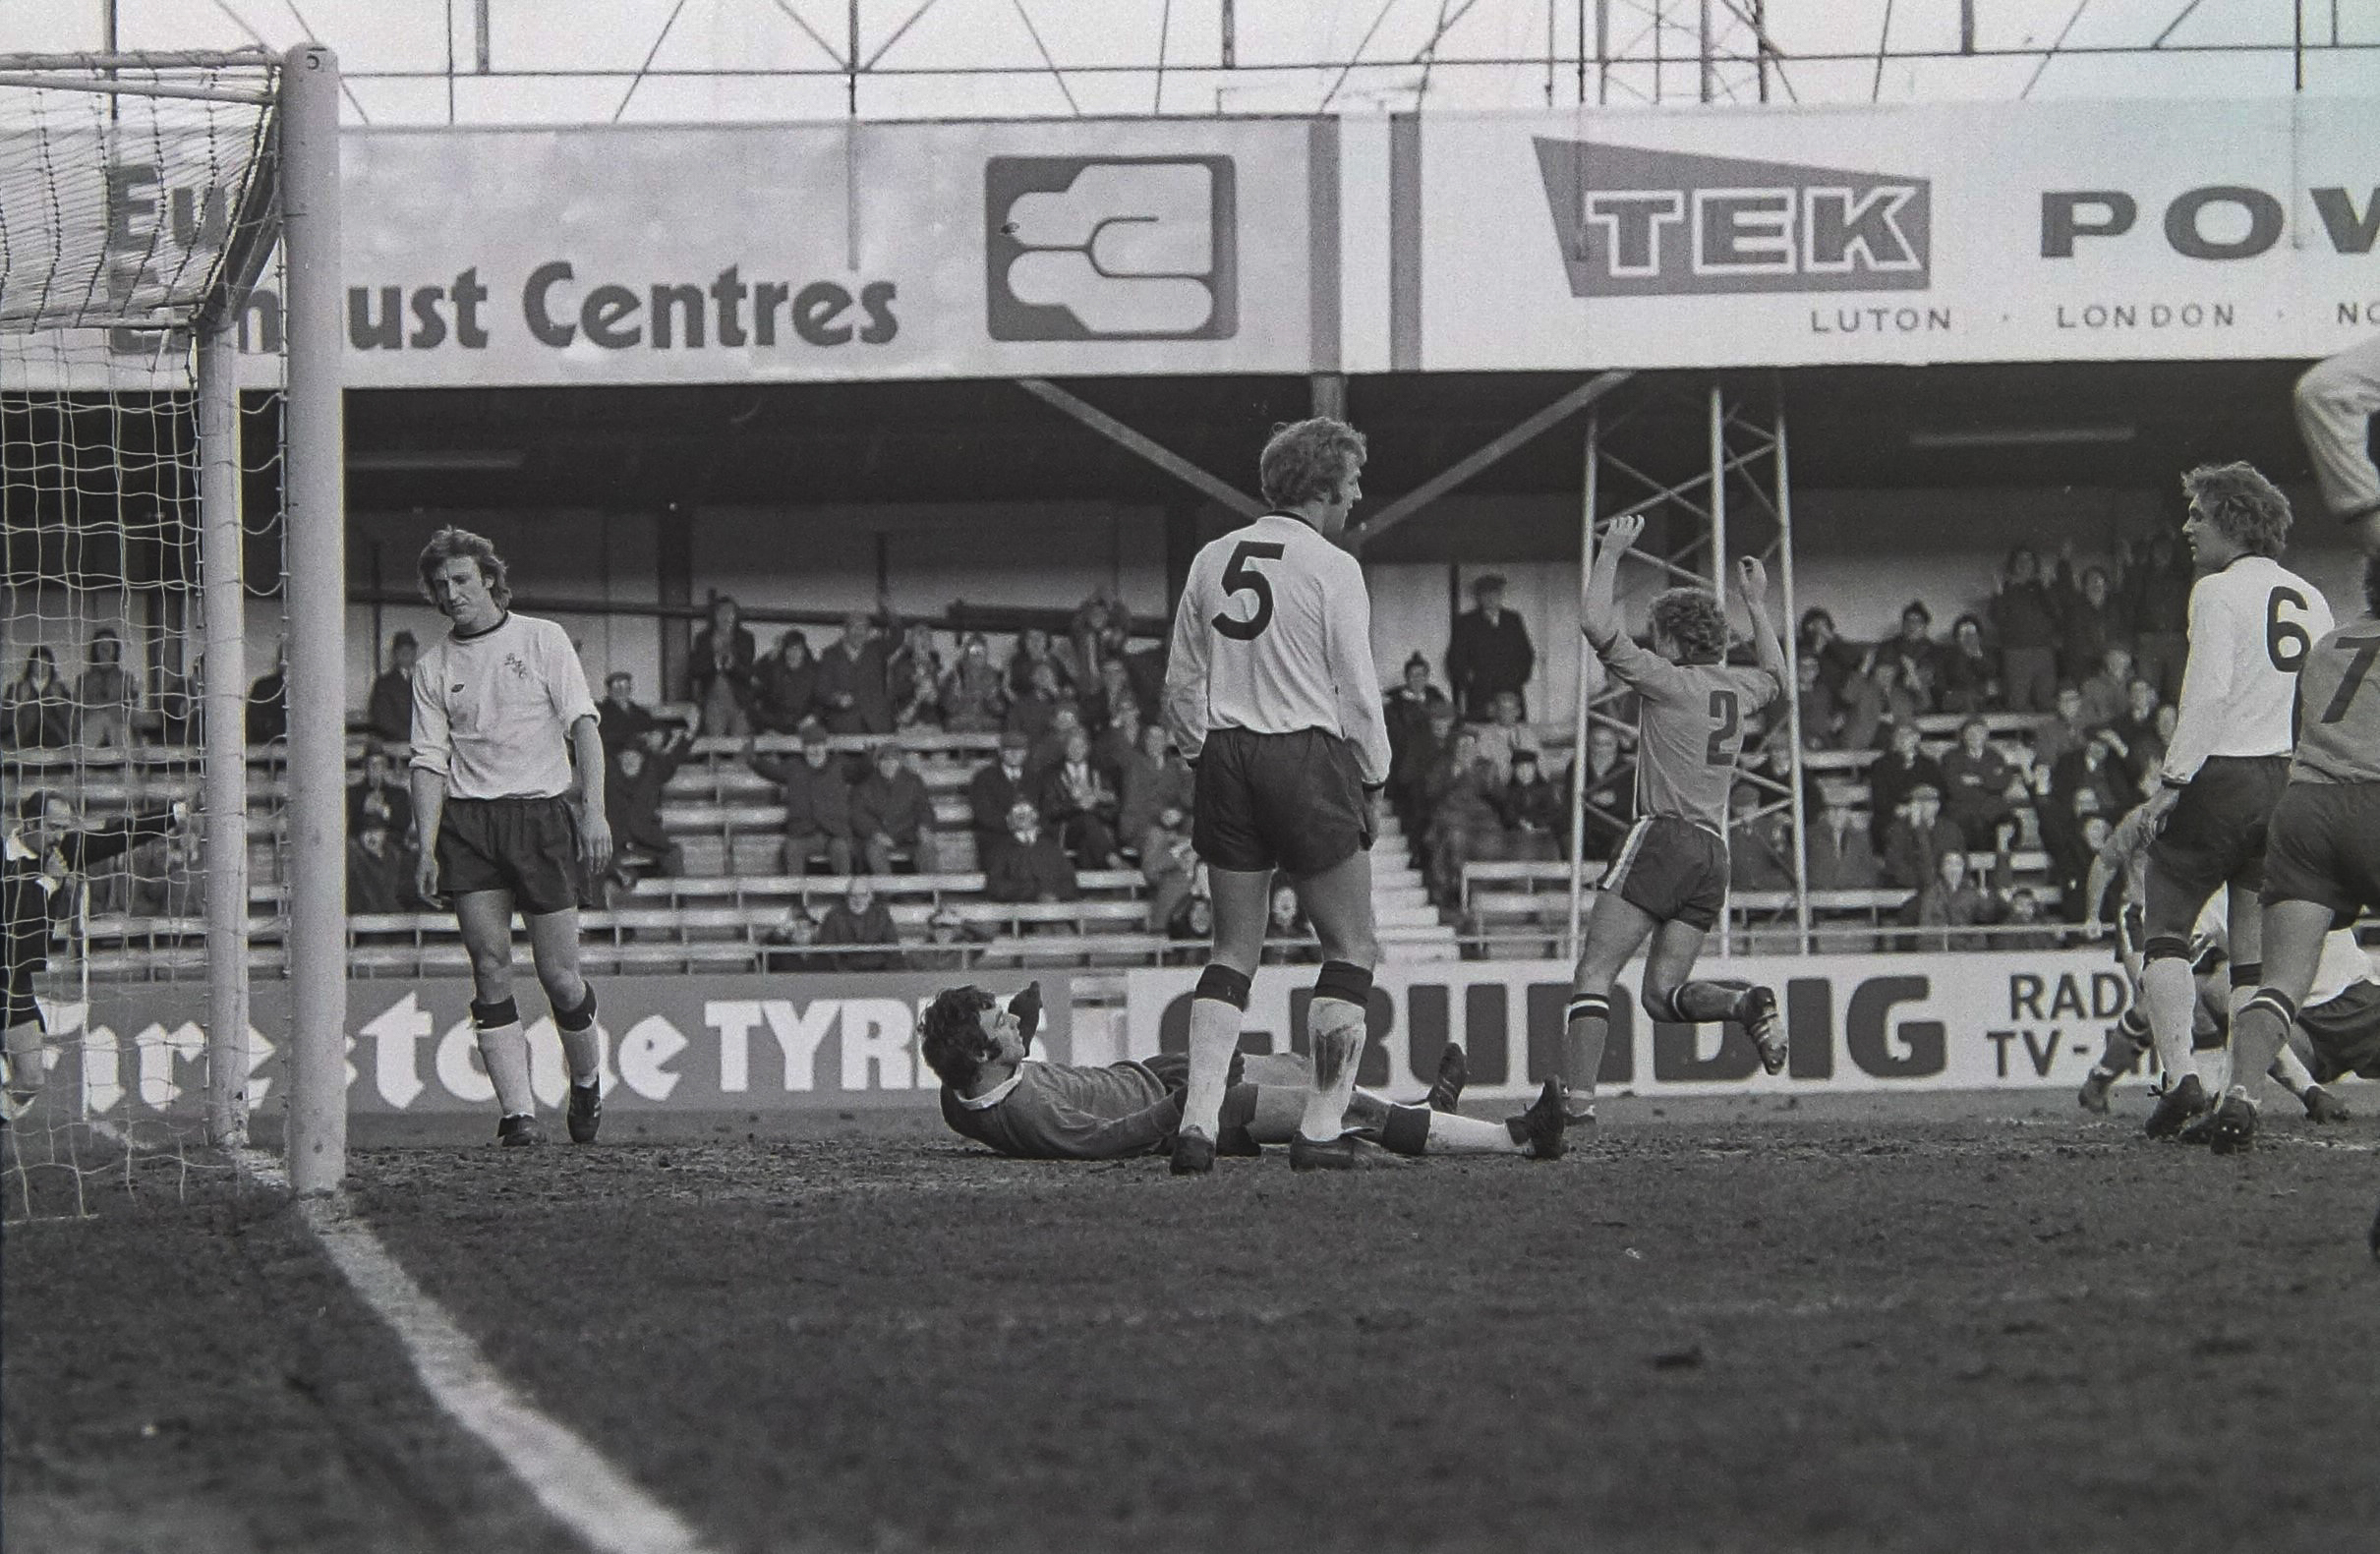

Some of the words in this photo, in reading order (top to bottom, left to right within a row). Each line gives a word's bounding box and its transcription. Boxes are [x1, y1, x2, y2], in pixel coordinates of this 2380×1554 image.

[1586, 186, 1923, 278] TEK
[522, 260, 899, 349] Centres
[1811, 307, 1952, 333] LUTON
[2056, 303, 2236, 329] LONDON
[1211, 540, 1286, 641] 5
[2266, 585, 2312, 673] 6
[2320, 635, 2380, 724] 7
[1706, 688, 1740, 768] 2
[704, 996, 1048, 1093] TYR
